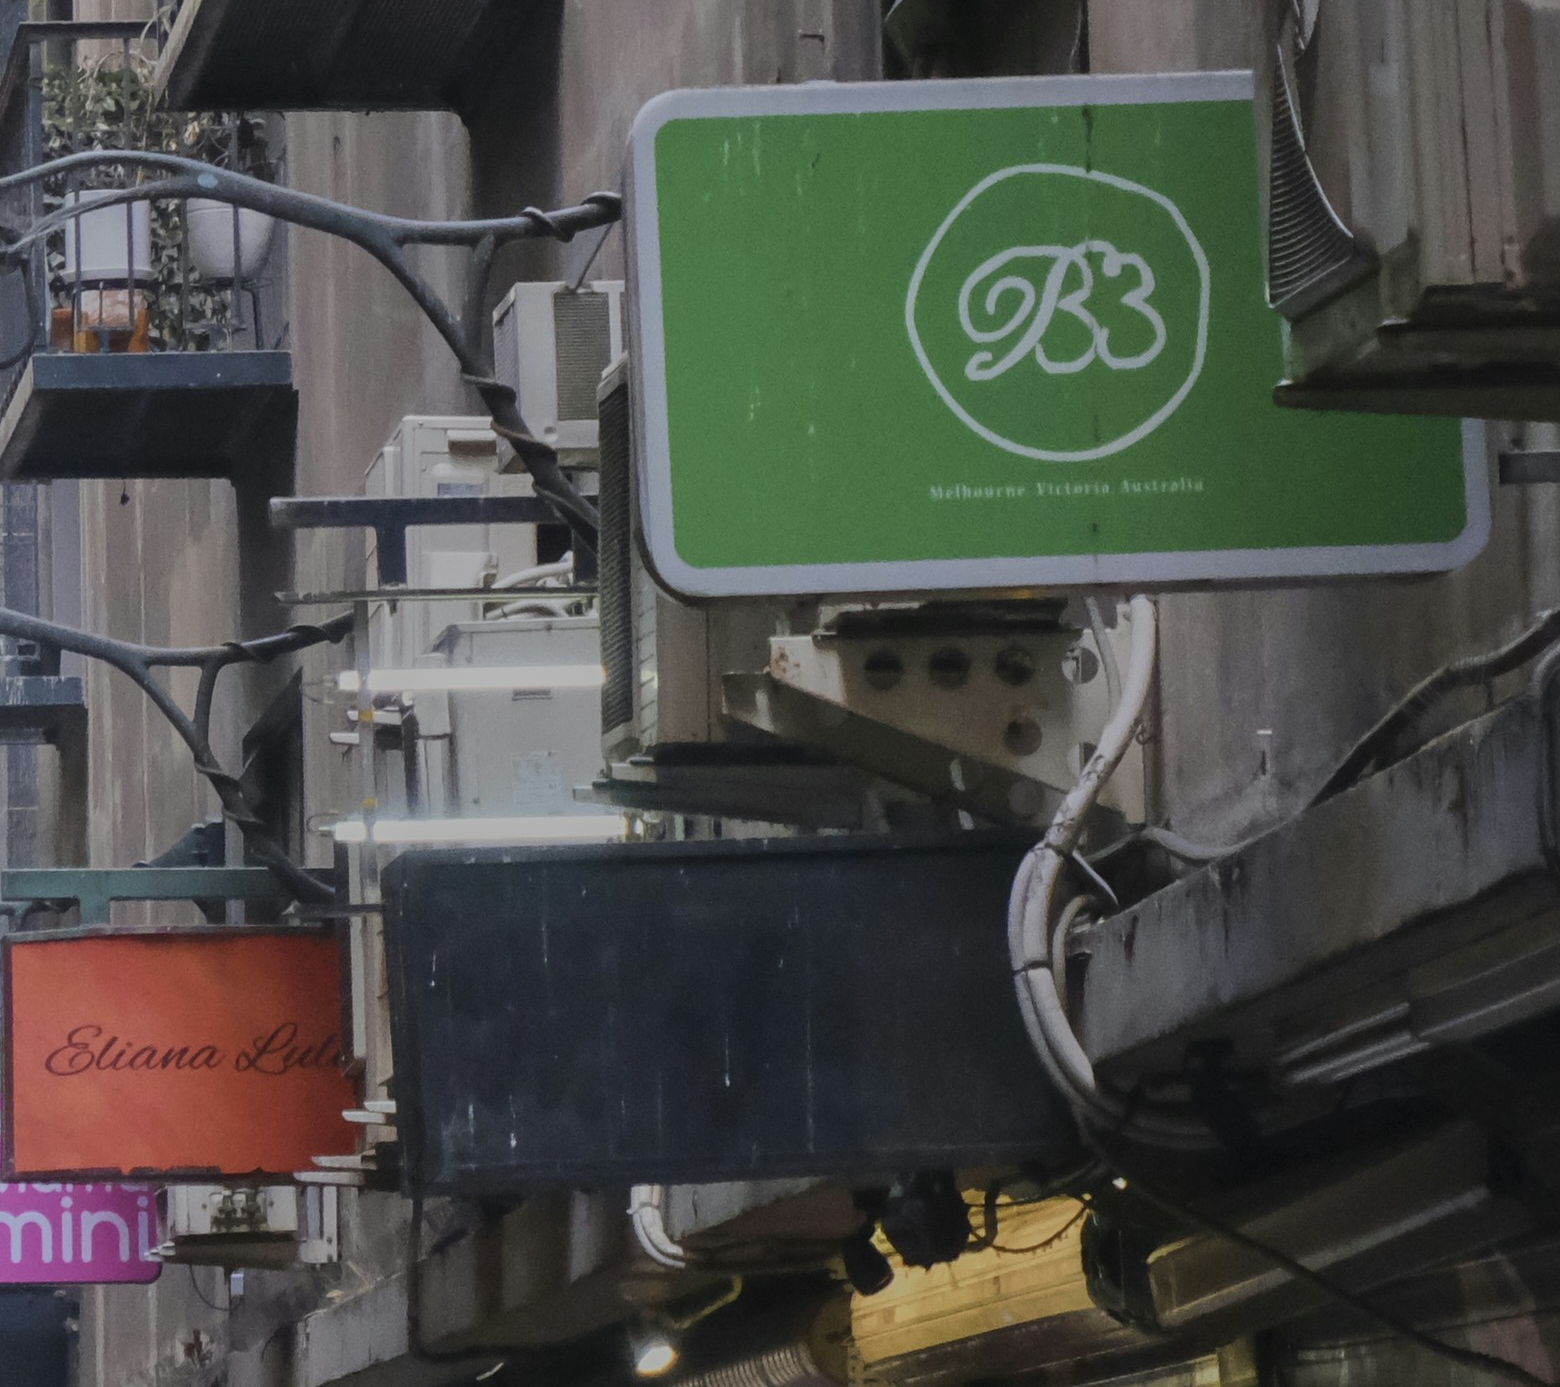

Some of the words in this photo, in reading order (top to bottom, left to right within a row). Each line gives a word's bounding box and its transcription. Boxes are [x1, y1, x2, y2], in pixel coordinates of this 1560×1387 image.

[929, 483, 1026, 502] Melbourne
[1036, 480, 1111, 497] Victoria
[1120, 476, 1206, 494] Australia
[45, 1024, 225, 1076] Eliana
